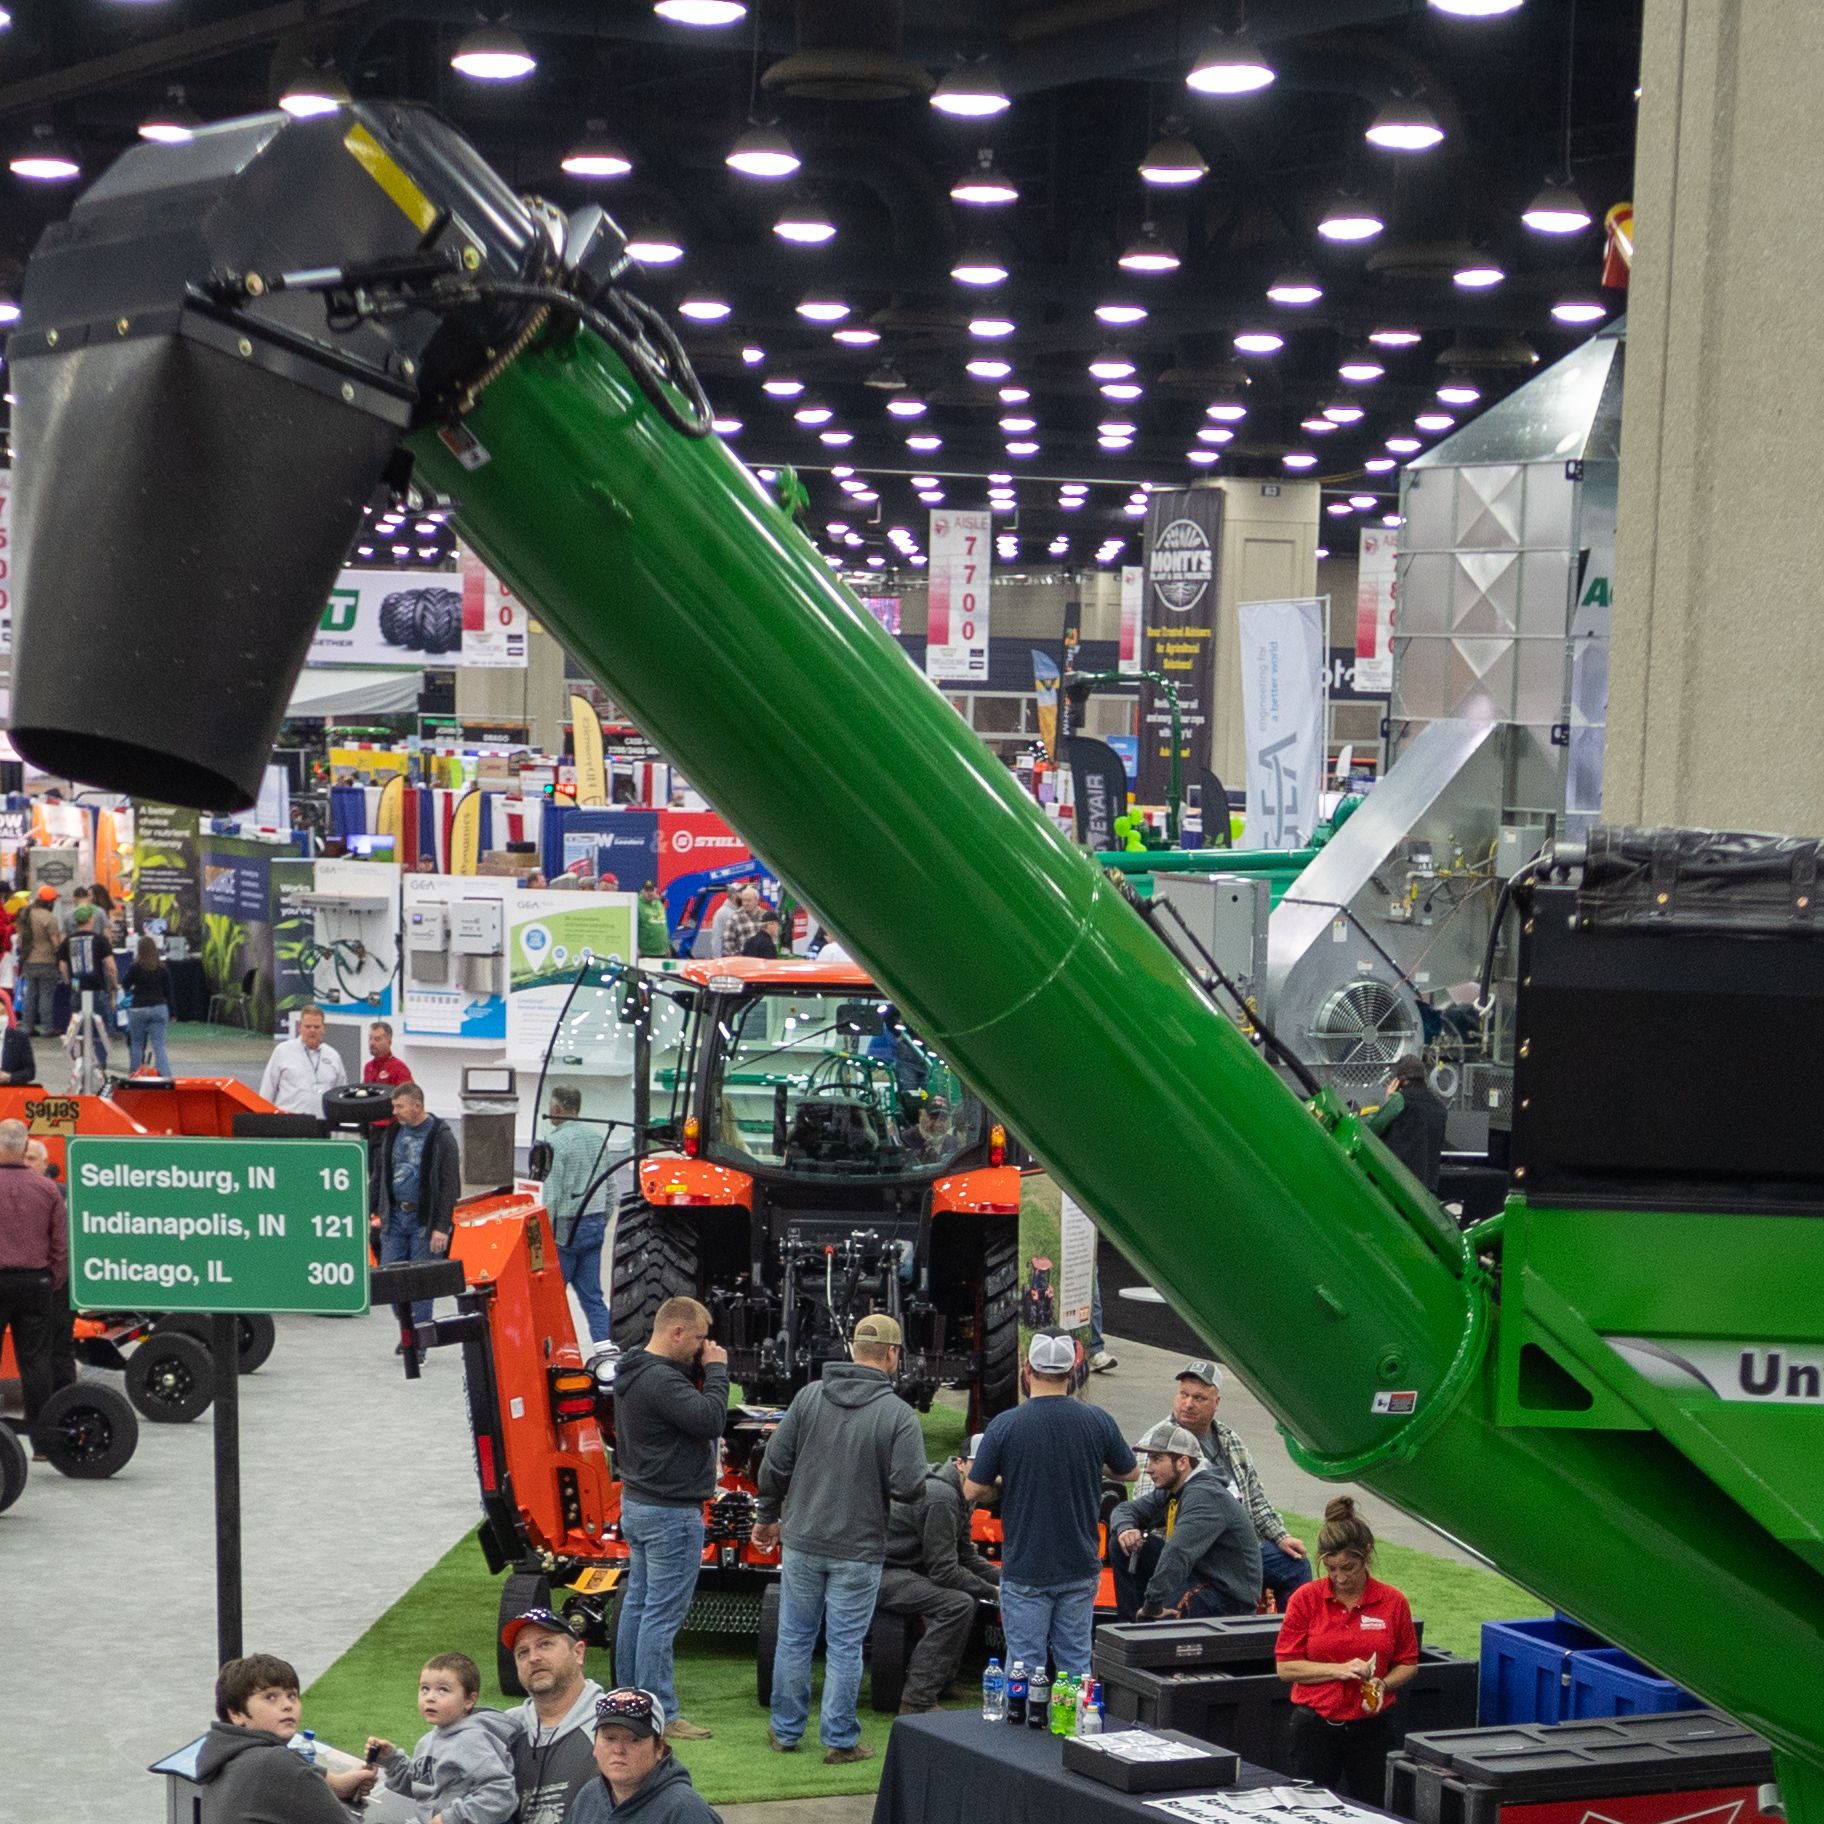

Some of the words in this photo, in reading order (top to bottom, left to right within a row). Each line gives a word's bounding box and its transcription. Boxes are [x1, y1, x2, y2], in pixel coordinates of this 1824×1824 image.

[1150, 549, 1212, 571] MONTY'S
[25, 1100, 80, 1120] Series
[80, 1163, 240, 1194] Sellersburg,
[248, 1166, 276, 1189] IN
[319, 1168, 350, 1190] 16
[82, 1211, 251, 1240] Indianapolis,
[258, 1214, 286, 1237] IN
[311, 1215, 353, 1238] 121
[83, 1257, 200, 1288] Chicago,
[207, 1260, 232, 1283] IL
[307, 1262, 354, 1286] 300
